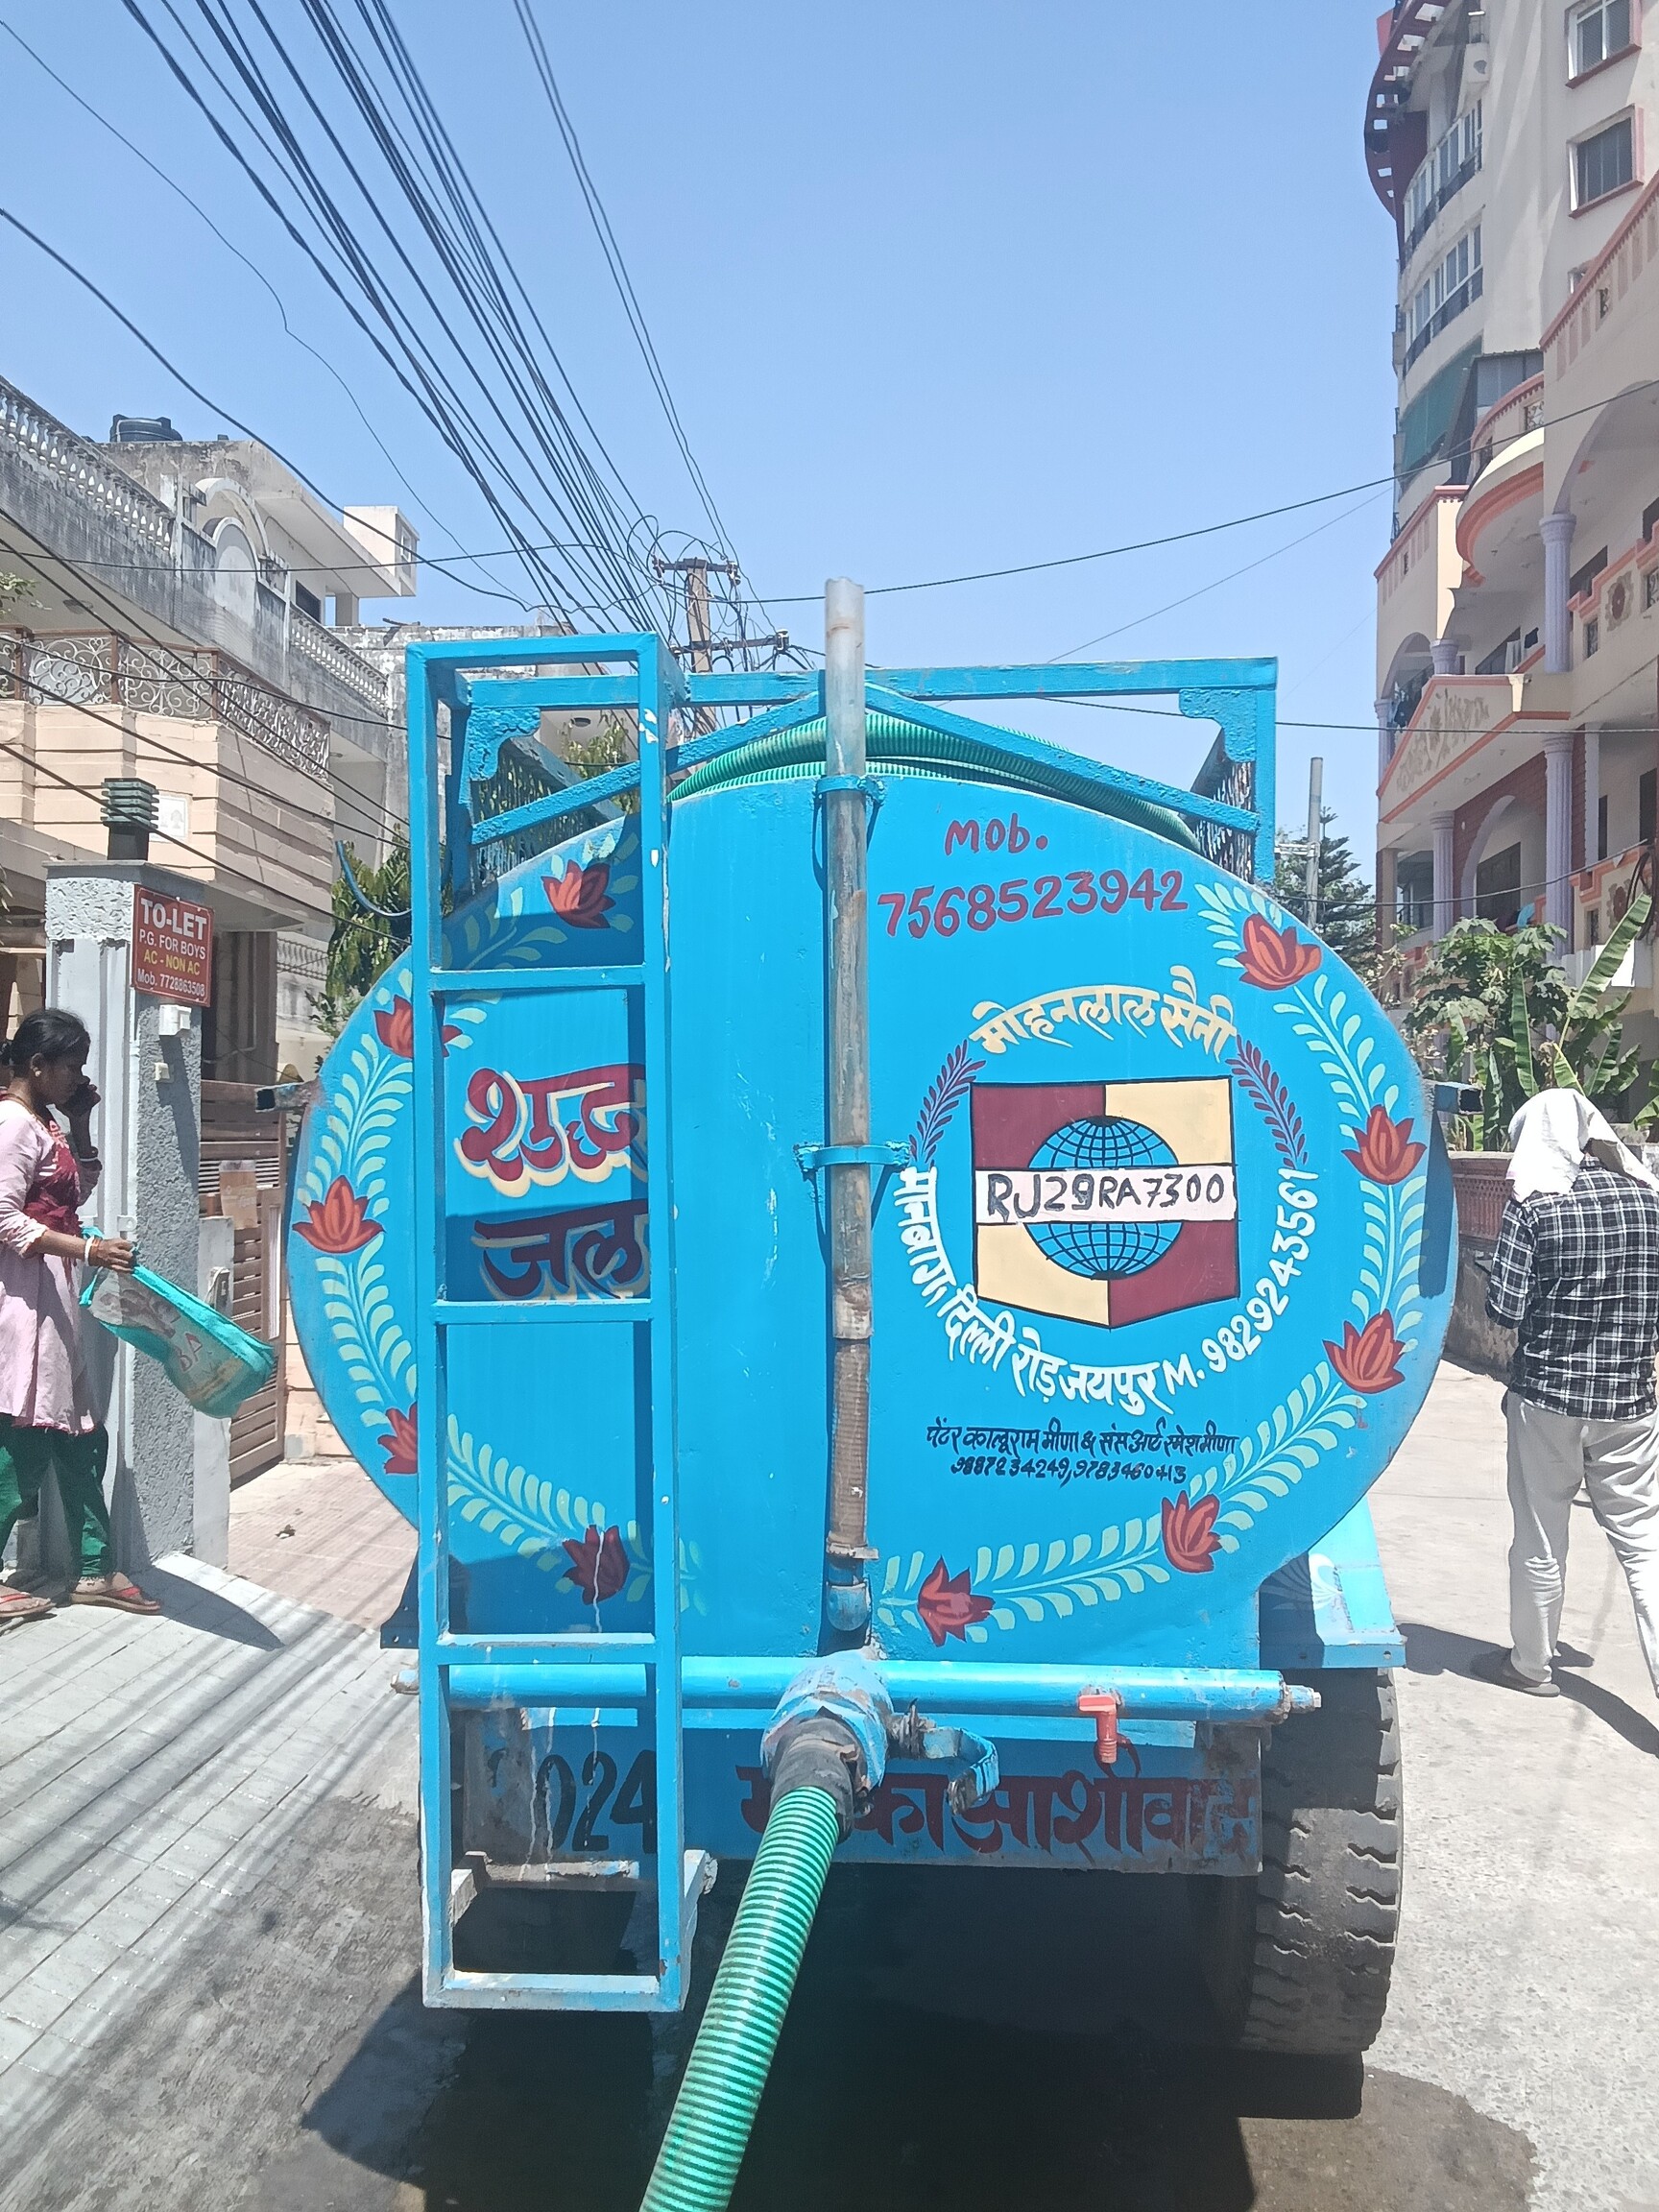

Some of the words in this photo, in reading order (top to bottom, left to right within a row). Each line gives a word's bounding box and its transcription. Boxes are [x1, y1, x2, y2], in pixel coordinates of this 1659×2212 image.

[140, 898, 207, 940] TO-LET
[878, 869, 1189, 939] 7568523942
[139, 928, 156, 947] P.G.
[158, 934, 179, 952] FOR
[180, 941, 205, 960] BOYS
[144, 949, 158, 965] AC
[165, 953, 186, 972] NON
[187, 960, 200, 975] AC
[137, 968, 158, 986] Mob.
[969, 985, 1160, 1054] मोहनलाल
[1160, 965, 1237, 1064] सैनी
[987, 1173, 1225, 1223] RJ29RA7300
[470, 1198, 649, 1300] जल
[937, 1283, 1017, 1372] दिल्ली
[1058, 1361, 1175, 1416] जयपुर
[1162, 1353, 1206, 1396] M.
[1201, 1167, 1319, 1373] 9829243561
[962, 1427, 1041, 1458] कालूराम
[1042, 1416, 1079, 1454] मीणा
[1199, 1420, 1239, 1455] मीणा
[487, 1747, 657, 1854] 024
